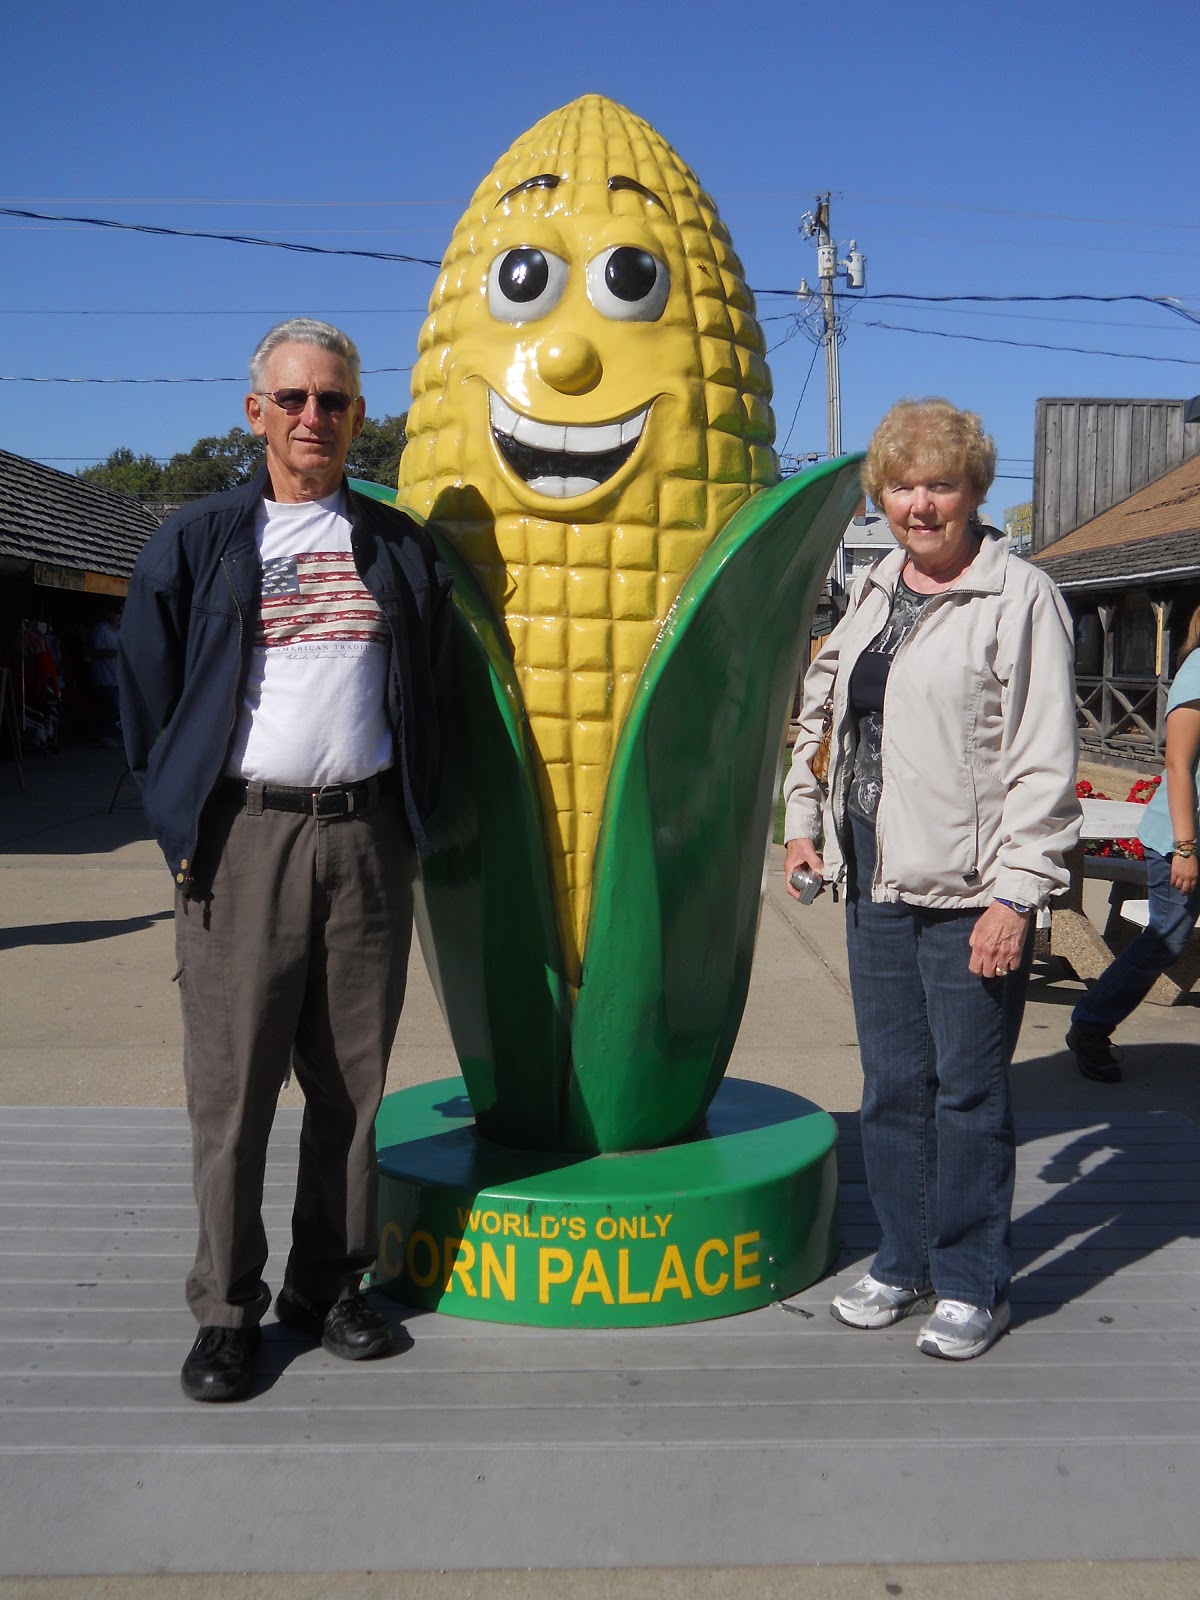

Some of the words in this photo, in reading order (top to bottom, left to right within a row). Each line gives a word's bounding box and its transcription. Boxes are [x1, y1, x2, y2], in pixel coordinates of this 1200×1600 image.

[275, 645, 329, 653] AMERICAN
[457, 1207, 586, 1240] WORLD'S
[596, 1213, 673, 1240] ONLY
[379, 1221, 516, 1301] CORN
[538, 1231, 761, 1306] PALACE
